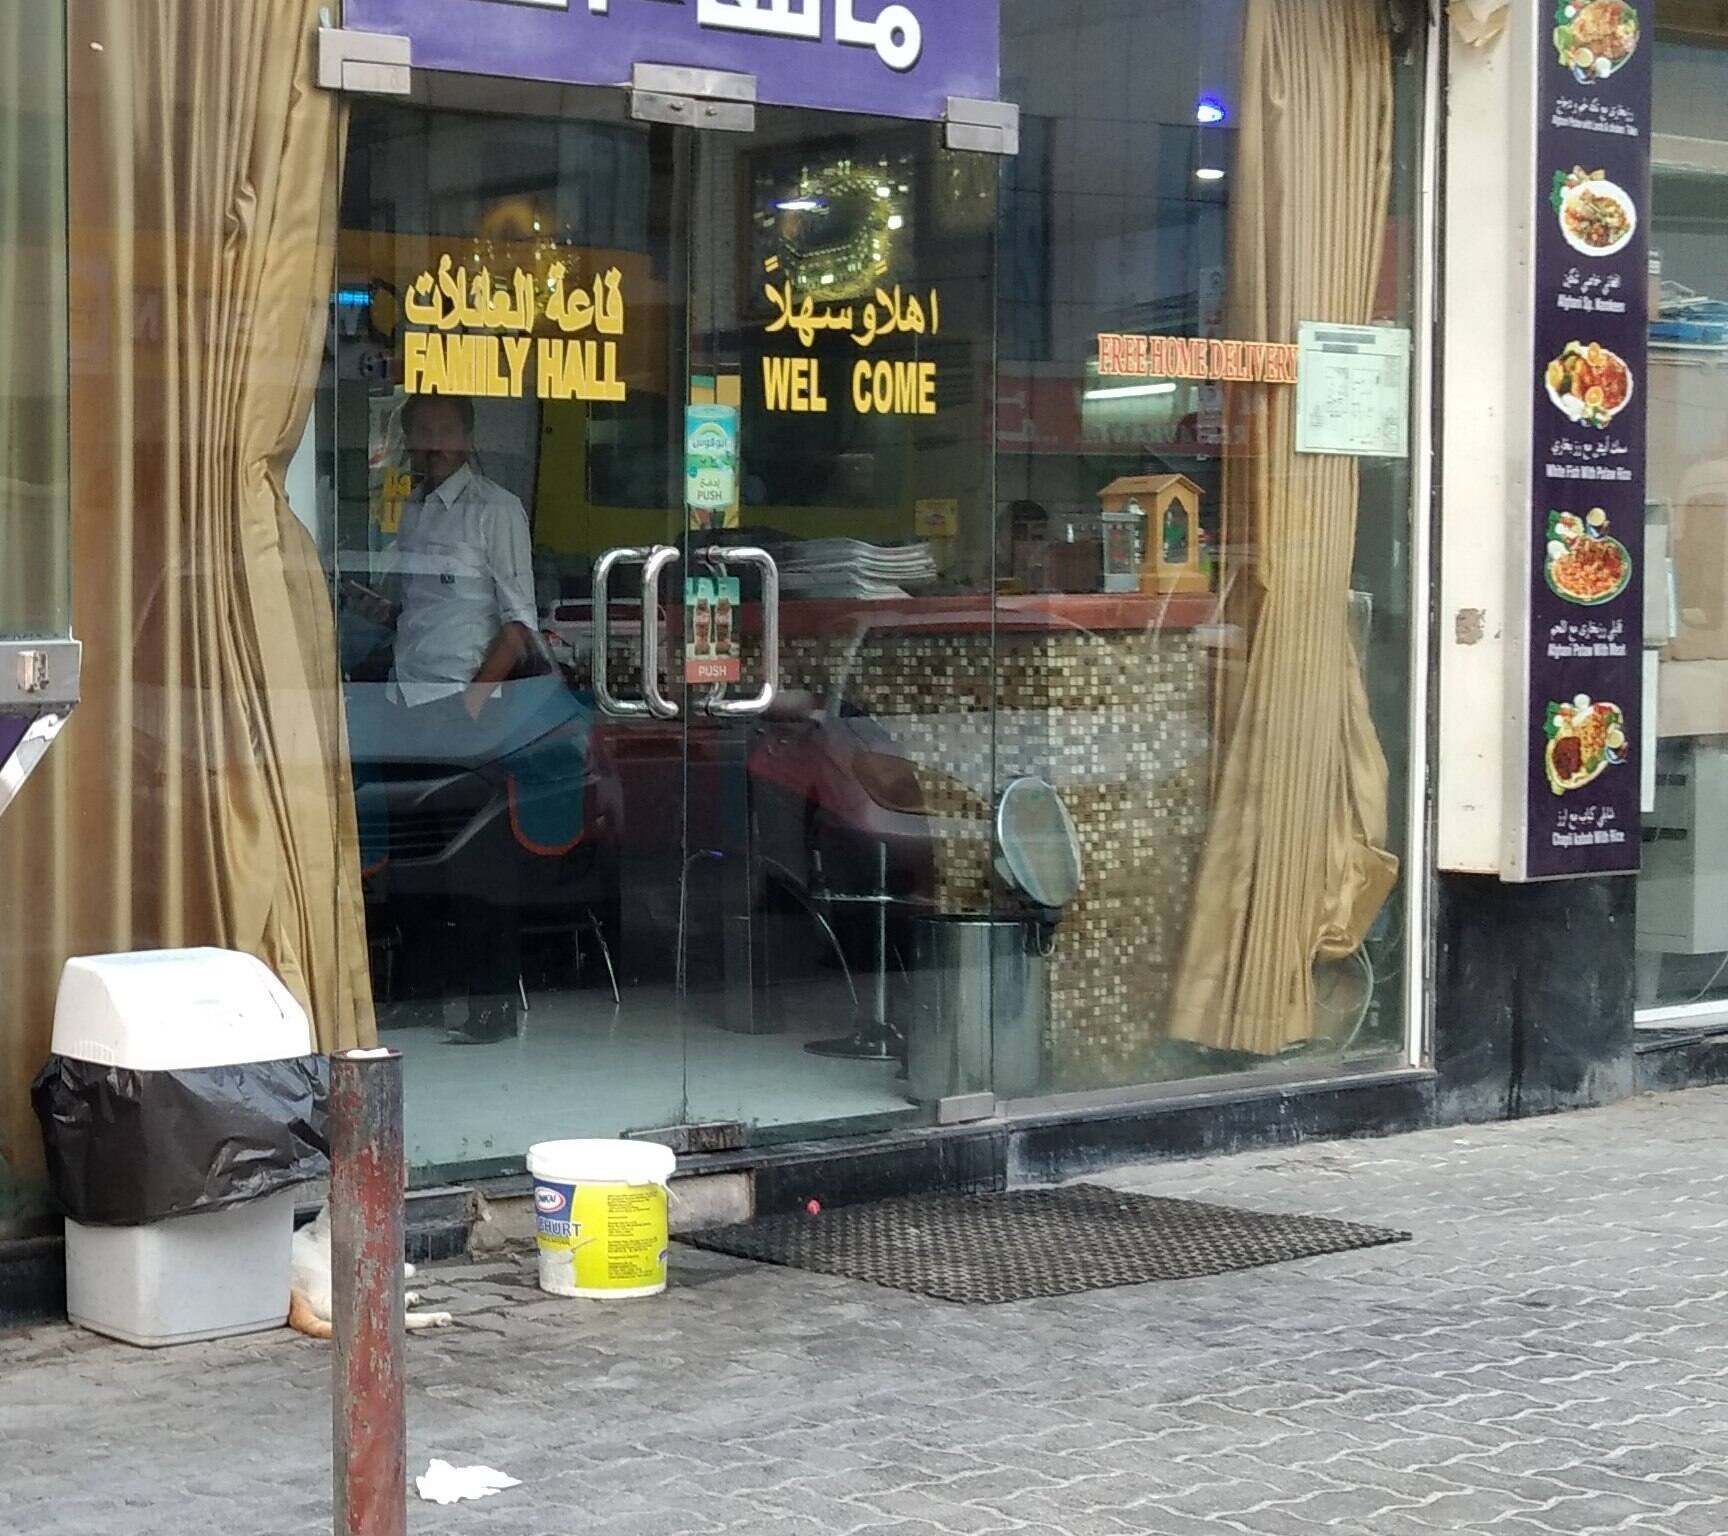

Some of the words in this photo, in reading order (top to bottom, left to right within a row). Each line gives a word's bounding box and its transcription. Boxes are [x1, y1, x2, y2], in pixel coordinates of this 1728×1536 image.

[545, 261, 624, 335] قاعة
[404, 331, 532, 399] FAMILY
[537, 337, 626, 402] HALL
[762, 356, 828, 412] WEL
[852, 359, 937, 414] COME
[1097, 333, 1149, 377] FREE
[1149, 336, 1210, 381] HOME
[1209, 339, 1299, 384] DELIVERY
[697, 490, 722, 501] PUSH
[698, 665, 728, 677] PUSH
